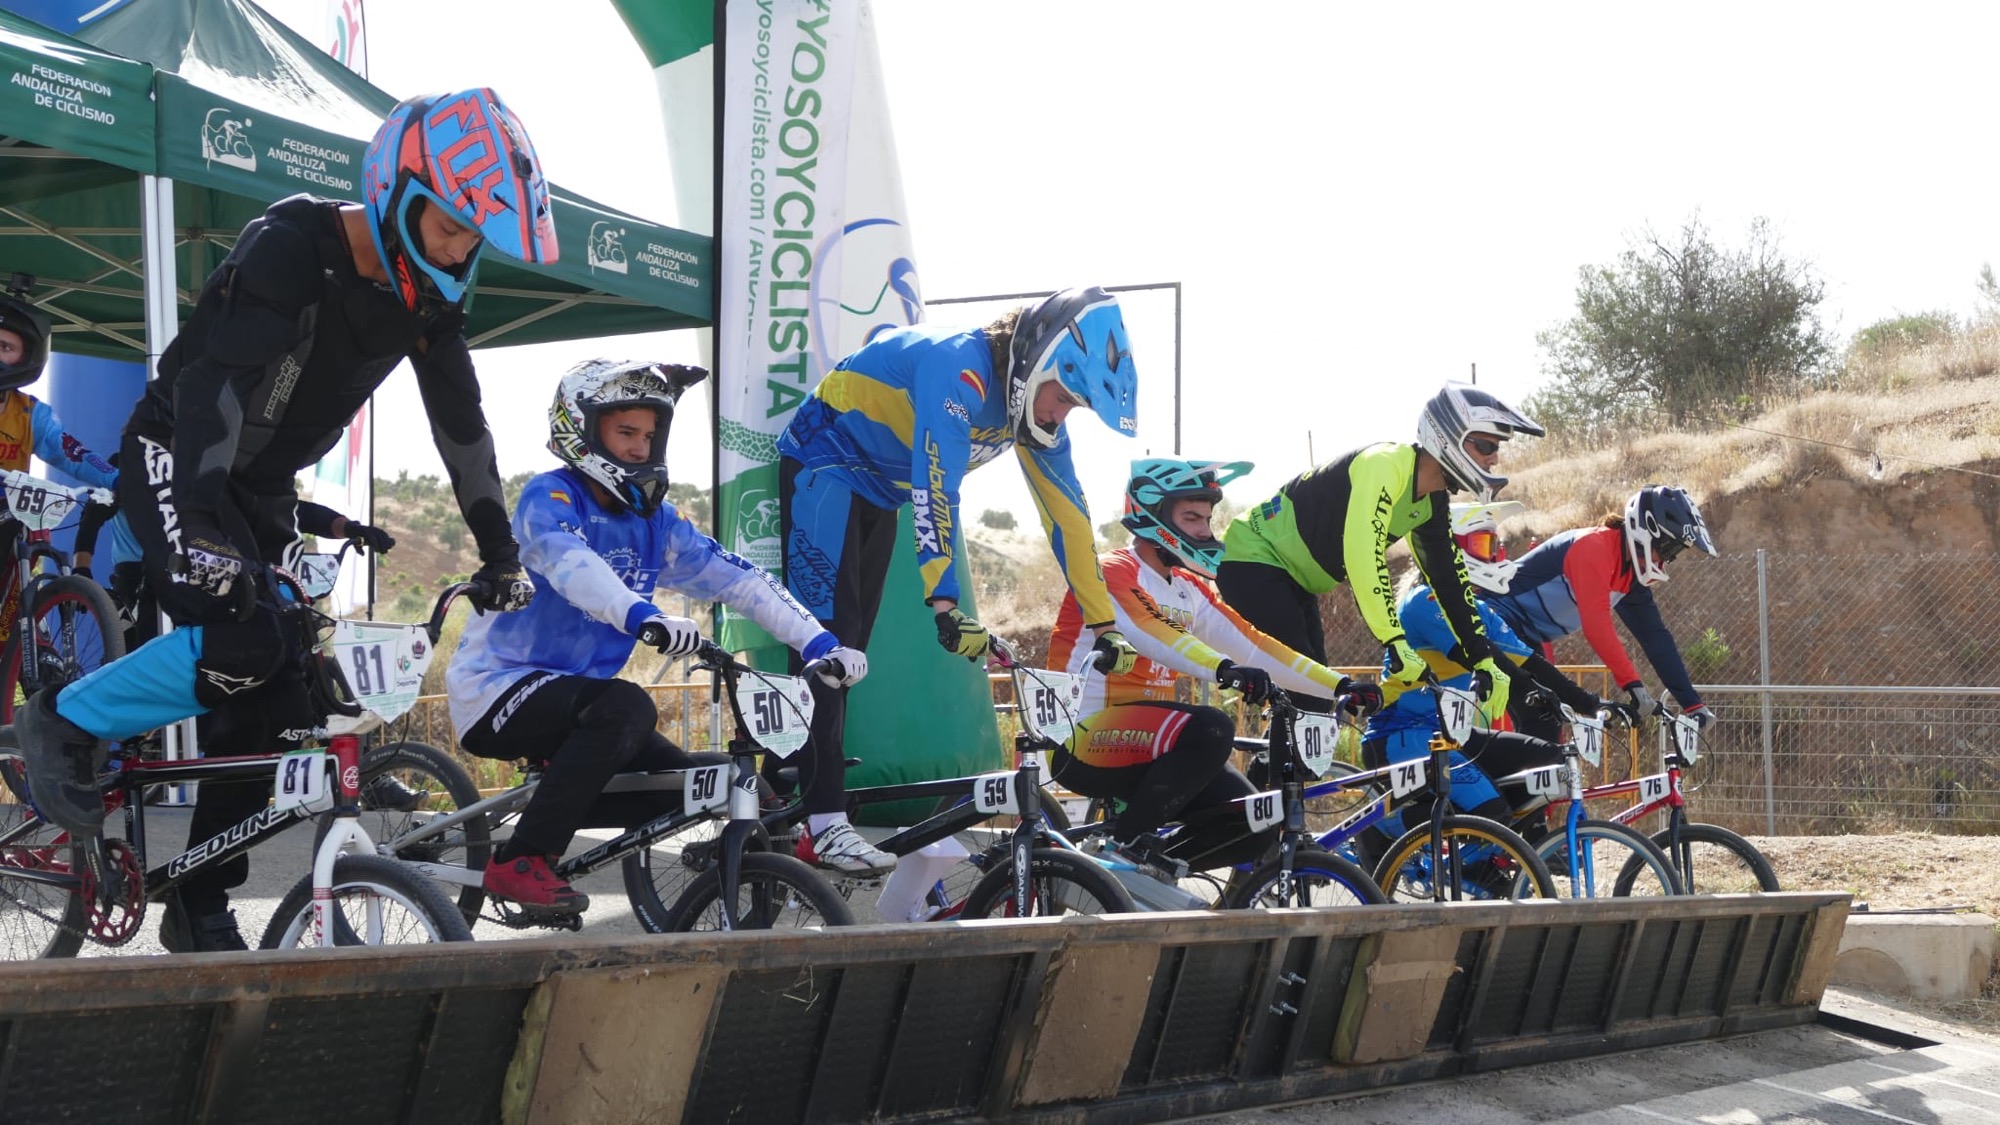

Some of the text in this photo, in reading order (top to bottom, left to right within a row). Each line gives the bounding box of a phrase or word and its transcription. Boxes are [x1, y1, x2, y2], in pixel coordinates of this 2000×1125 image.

[10, 72, 84, 104] ANDALUZA
[31, 63, 112, 98] FEDERACIÓN
[34, 93, 116, 126] DE CICLISMO
[266, 148, 327, 173] ANDALUZA
[282, 138, 350, 165] FEDERACIÓN
[428, 94, 507, 227] FOX
[286, 164, 353, 192] DE CICLISMO
[635, 251, 681, 272] ANDALUZA
[647, 243, 698, 266] FEDERACIÓN
[649, 266, 699, 289] DE CICLISMO
[15, 485, 47, 516] 69
[911, 488, 939, 553] BMX
[352, 644, 387, 695] 81
[753, 690, 784, 735] 50
[1035, 688, 1057, 726] 59
[1451, 700, 1466, 729] 74
[1091, 729, 1155, 748] SUR SUN
[1305, 726, 1321, 759] 80
[1583, 725, 1597, 753] 70
[1683, 724, 1695, 750] 76
[282, 756, 313, 795] 81
[692, 768, 718, 800] 50
[1397, 766, 1417, 788] 74
[1535, 769, 1551, 789] 70
[1646, 777, 1662, 796] 76
[983, 779, 1008, 808] 59
[1253, 795, 1273, 822] 80
[1279, 869, 1292, 900] box
